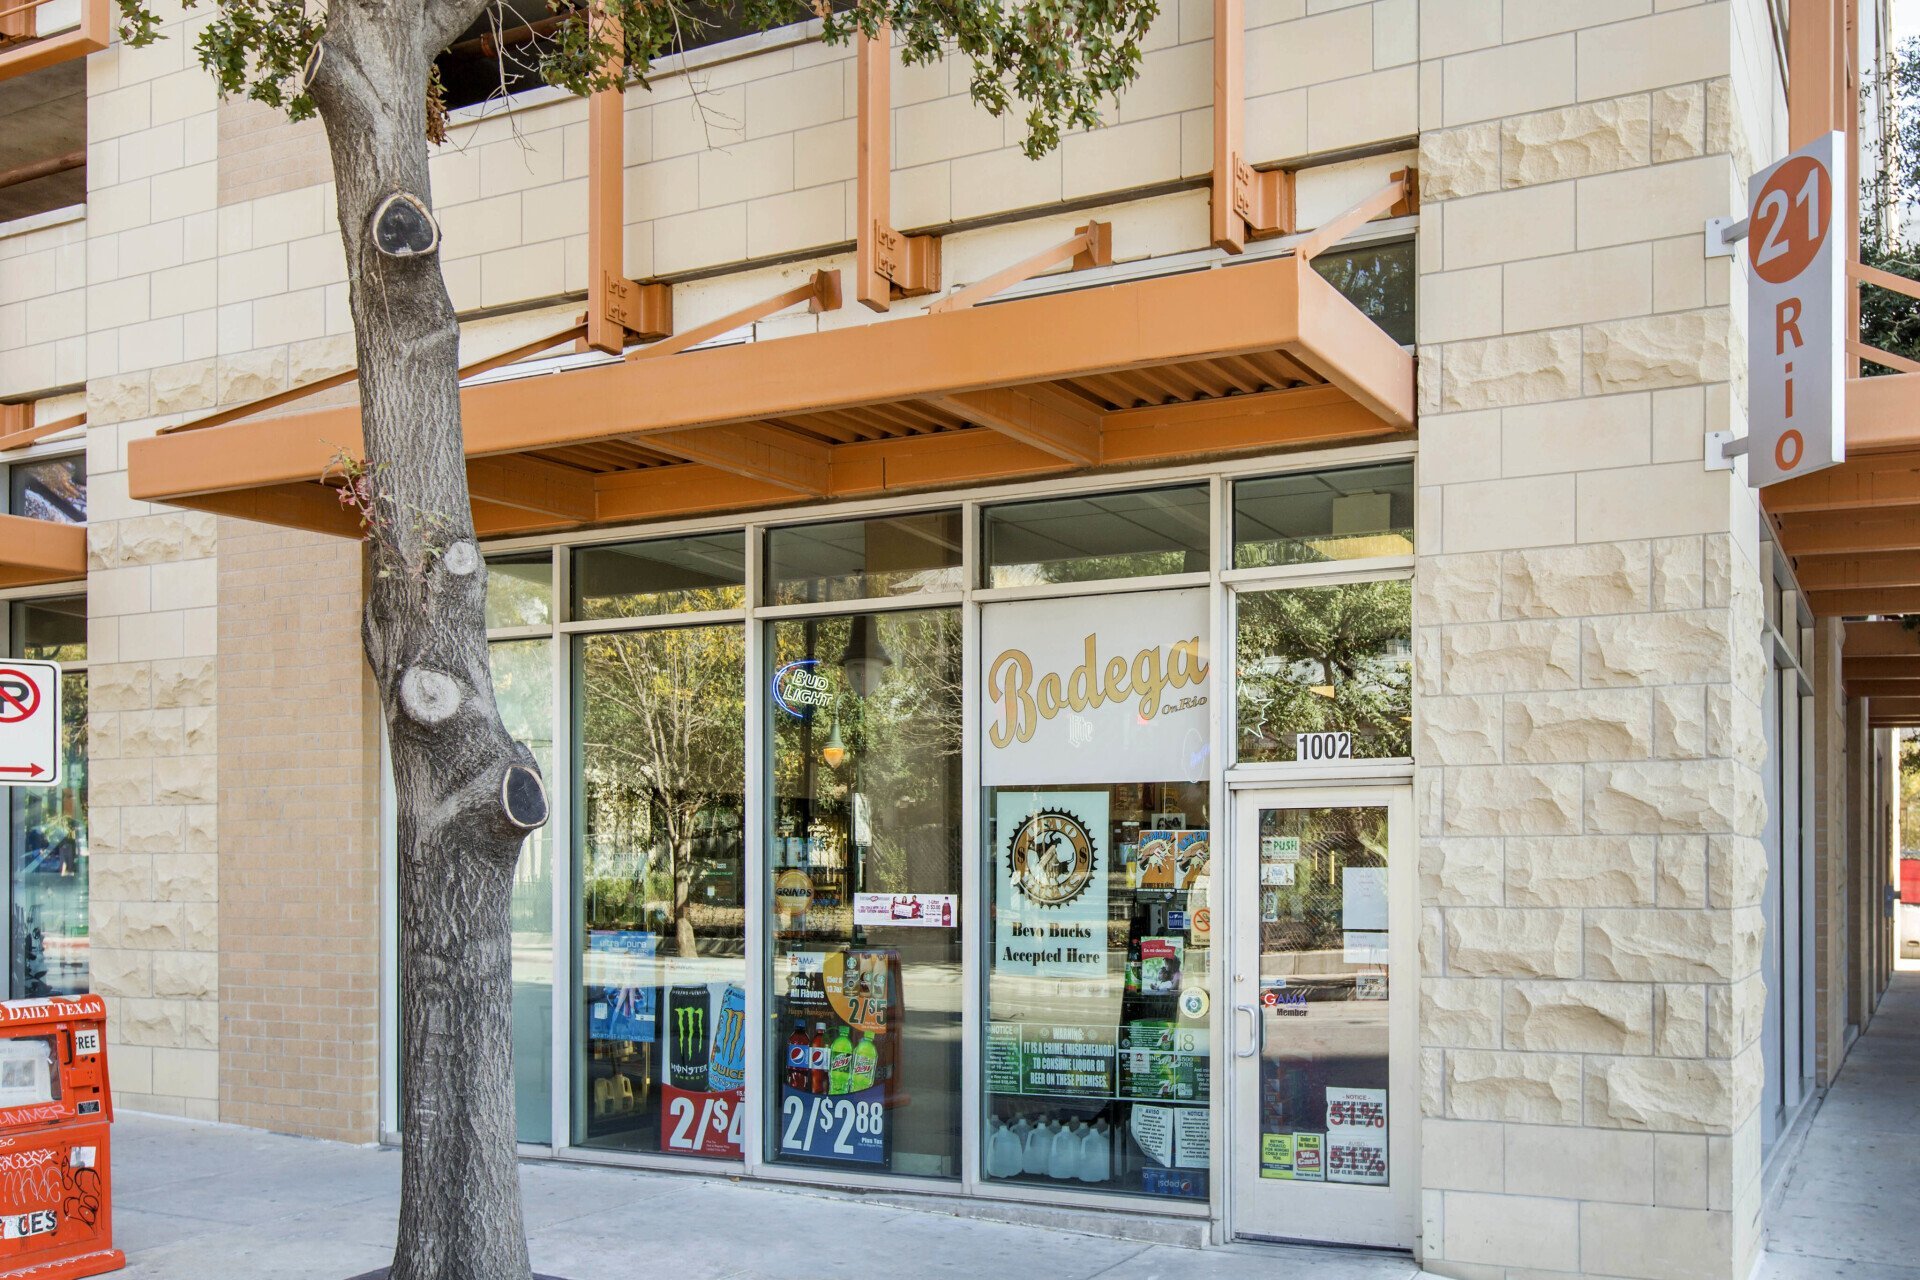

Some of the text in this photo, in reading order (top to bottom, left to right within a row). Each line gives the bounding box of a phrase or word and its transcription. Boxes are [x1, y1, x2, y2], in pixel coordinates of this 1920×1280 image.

[1756, 167, 1819, 267] 21
[783, 685, 833, 707] LIGHT
[988, 632, 1209, 749] Bodega
[1161, 695, 1208, 715] On Rio
[1299, 733, 1350, 761] 1002
[1273, 840, 1298, 851] PUSH
[775, 887, 812, 897] GRINDS
[1012, 922, 1092, 938] Bevo Bucks
[1003, 947, 1100, 966] Accepted Here
[791, 976, 807, 986] 20oz
[790, 988, 825, 999] All Flavors
[1264, 993, 1308, 1005] GAMA
[53, 1001, 101, 1017] TEXAN
[1277, 1008, 1309, 1017] Member
[991, 1025, 1013, 1035] NOTICE
[1052, 1027, 1085, 1041] WARNING:
[1024, 1041, 1031, 1054] IT
[1031, 1042, 1038, 1054] IS
[1038, 1043, 1043, 1054] A
[1043, 1043, 1063, 1055] CRIME
[670, 1063, 708, 1075] MONSTER
[1033, 1057, 1105, 1073] TO CONSUME LIQUOR OR
[1030, 1072, 1045, 1085] BEER
[1046, 1073, 1055, 1085] ON
[1055, 1073, 1075, 1087] THESE
[1330, 1103, 1385, 1128] 51%
[1329, 1147, 1385, 1173] 51%
